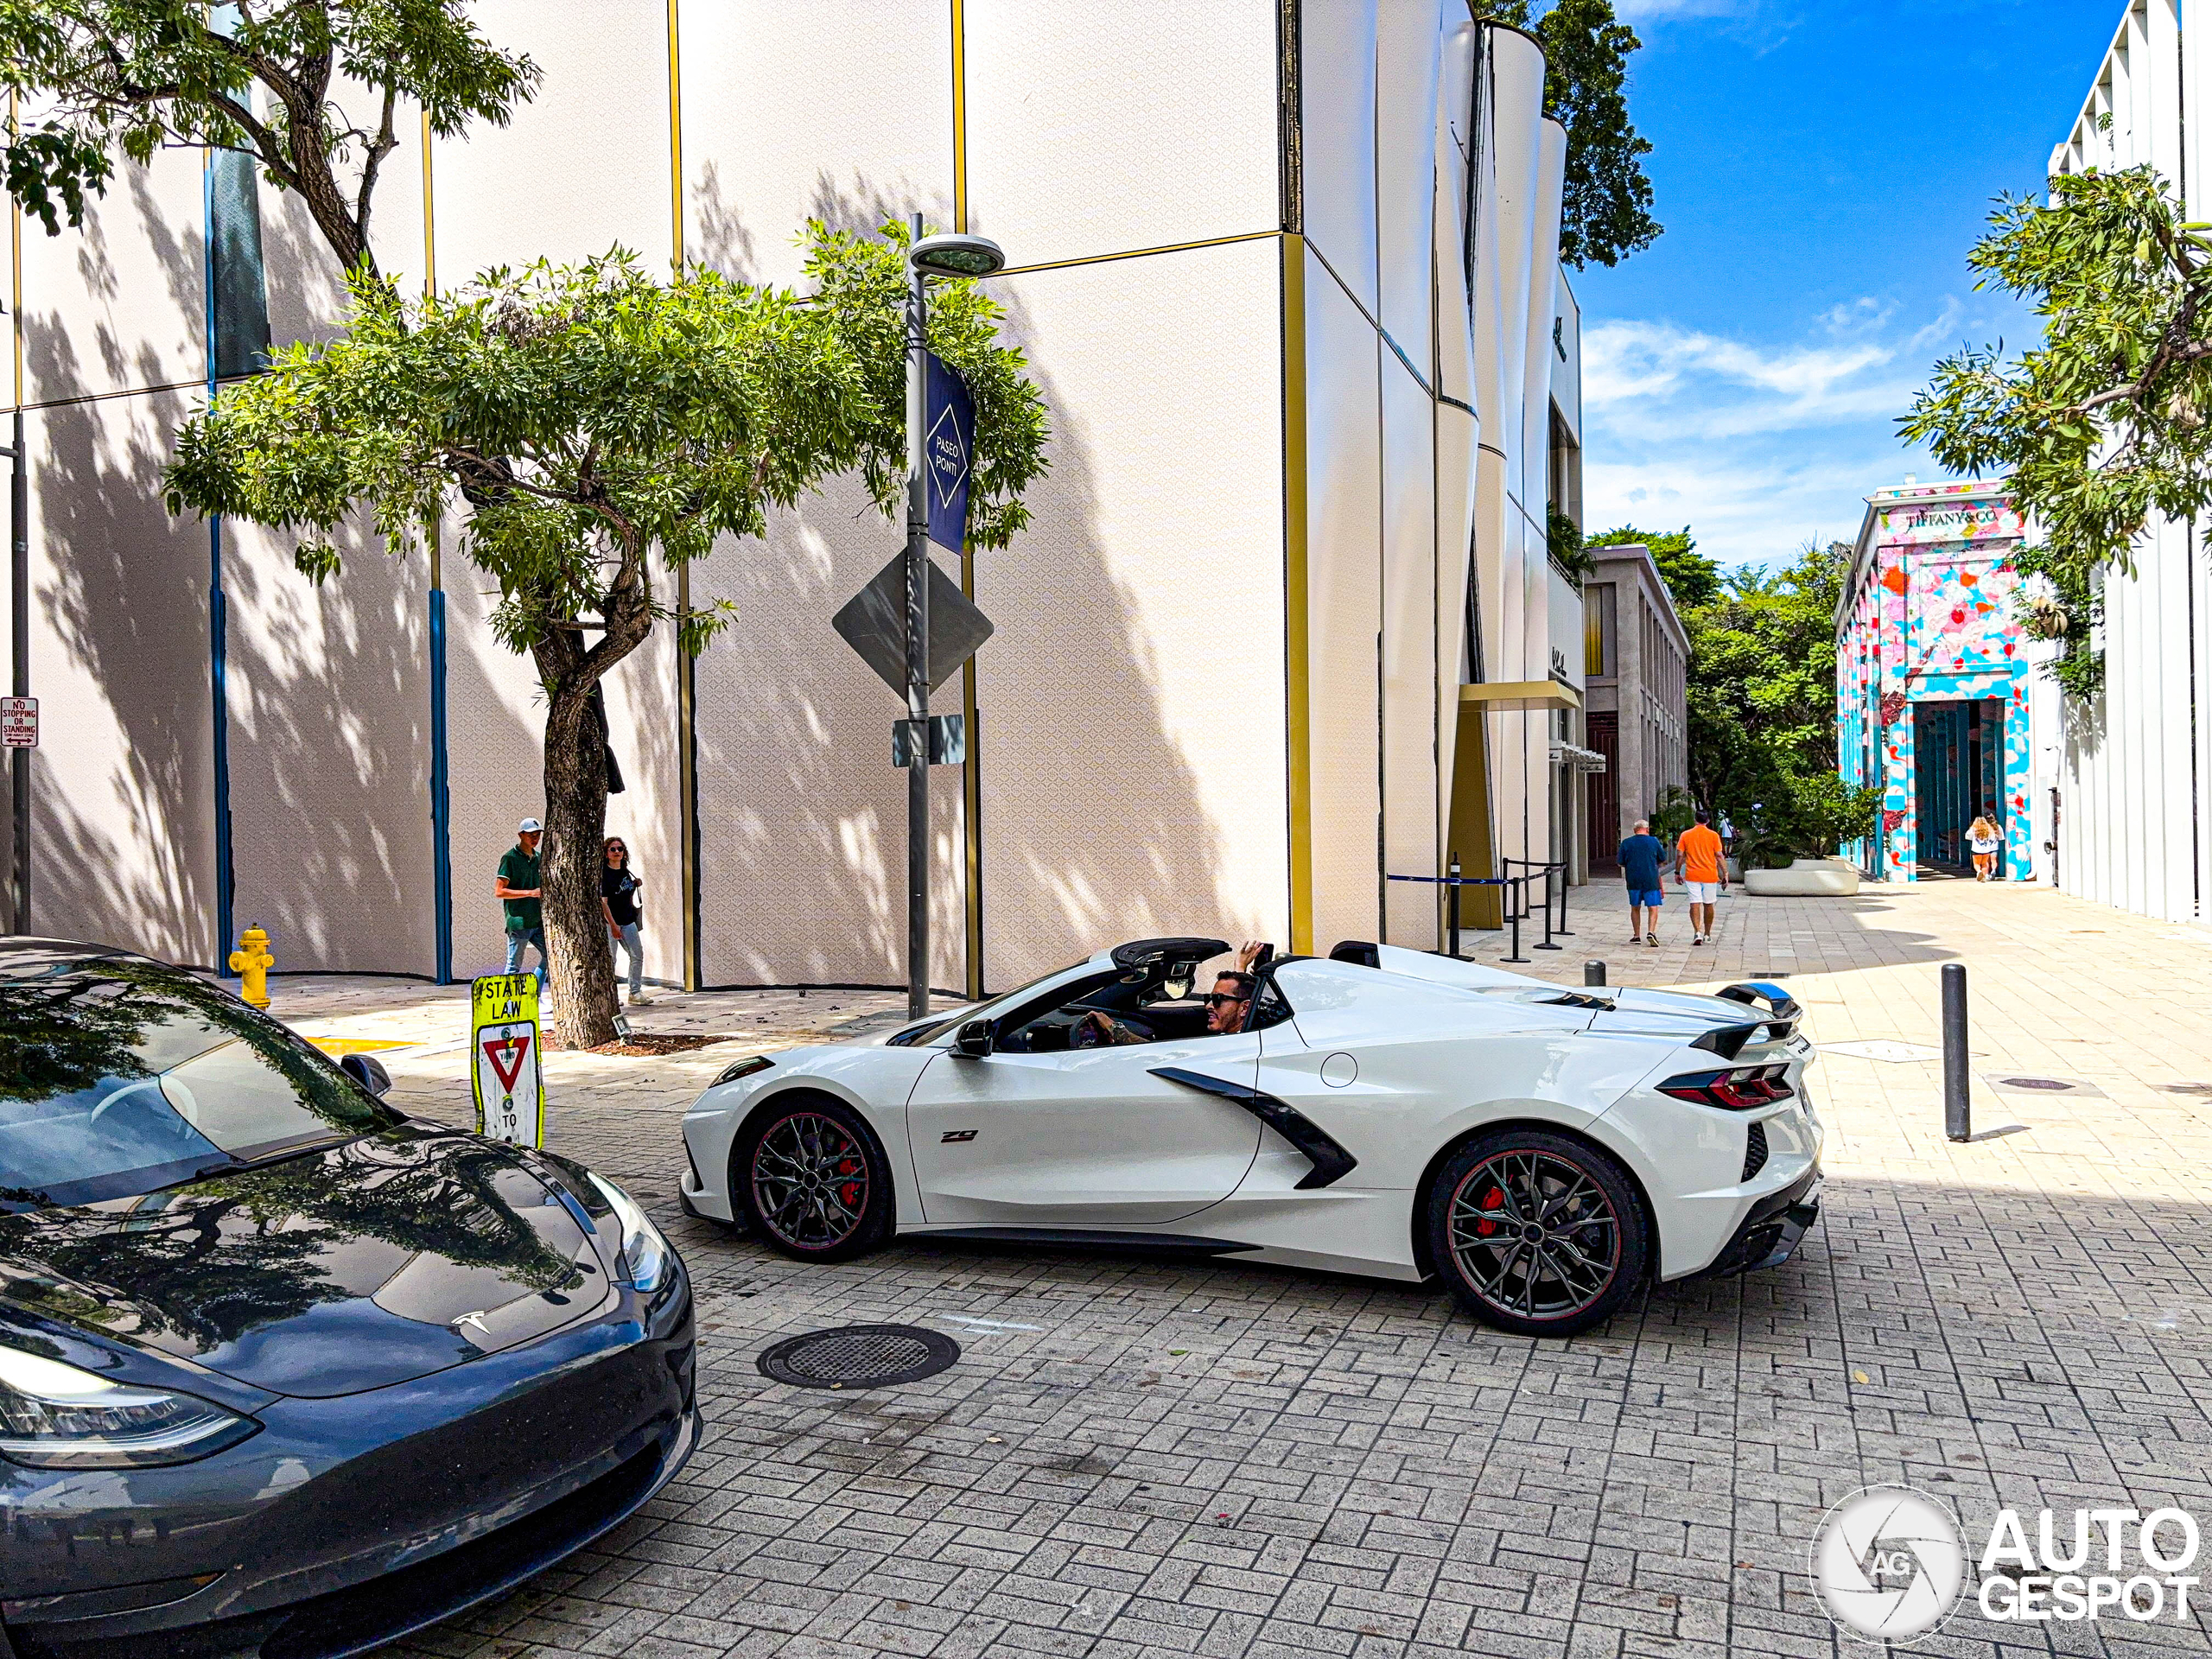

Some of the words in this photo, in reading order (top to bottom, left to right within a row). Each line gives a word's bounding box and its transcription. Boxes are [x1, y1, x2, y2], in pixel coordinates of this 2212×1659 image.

[937, 435, 958, 458] PASEO
[936, 454, 957, 477] PONTI
[13, 701, 25, 709] NO
[486, 979, 528, 999] STATE
[492, 1001, 521, 1020] LAW
[502, 1114, 517, 1128] TO
